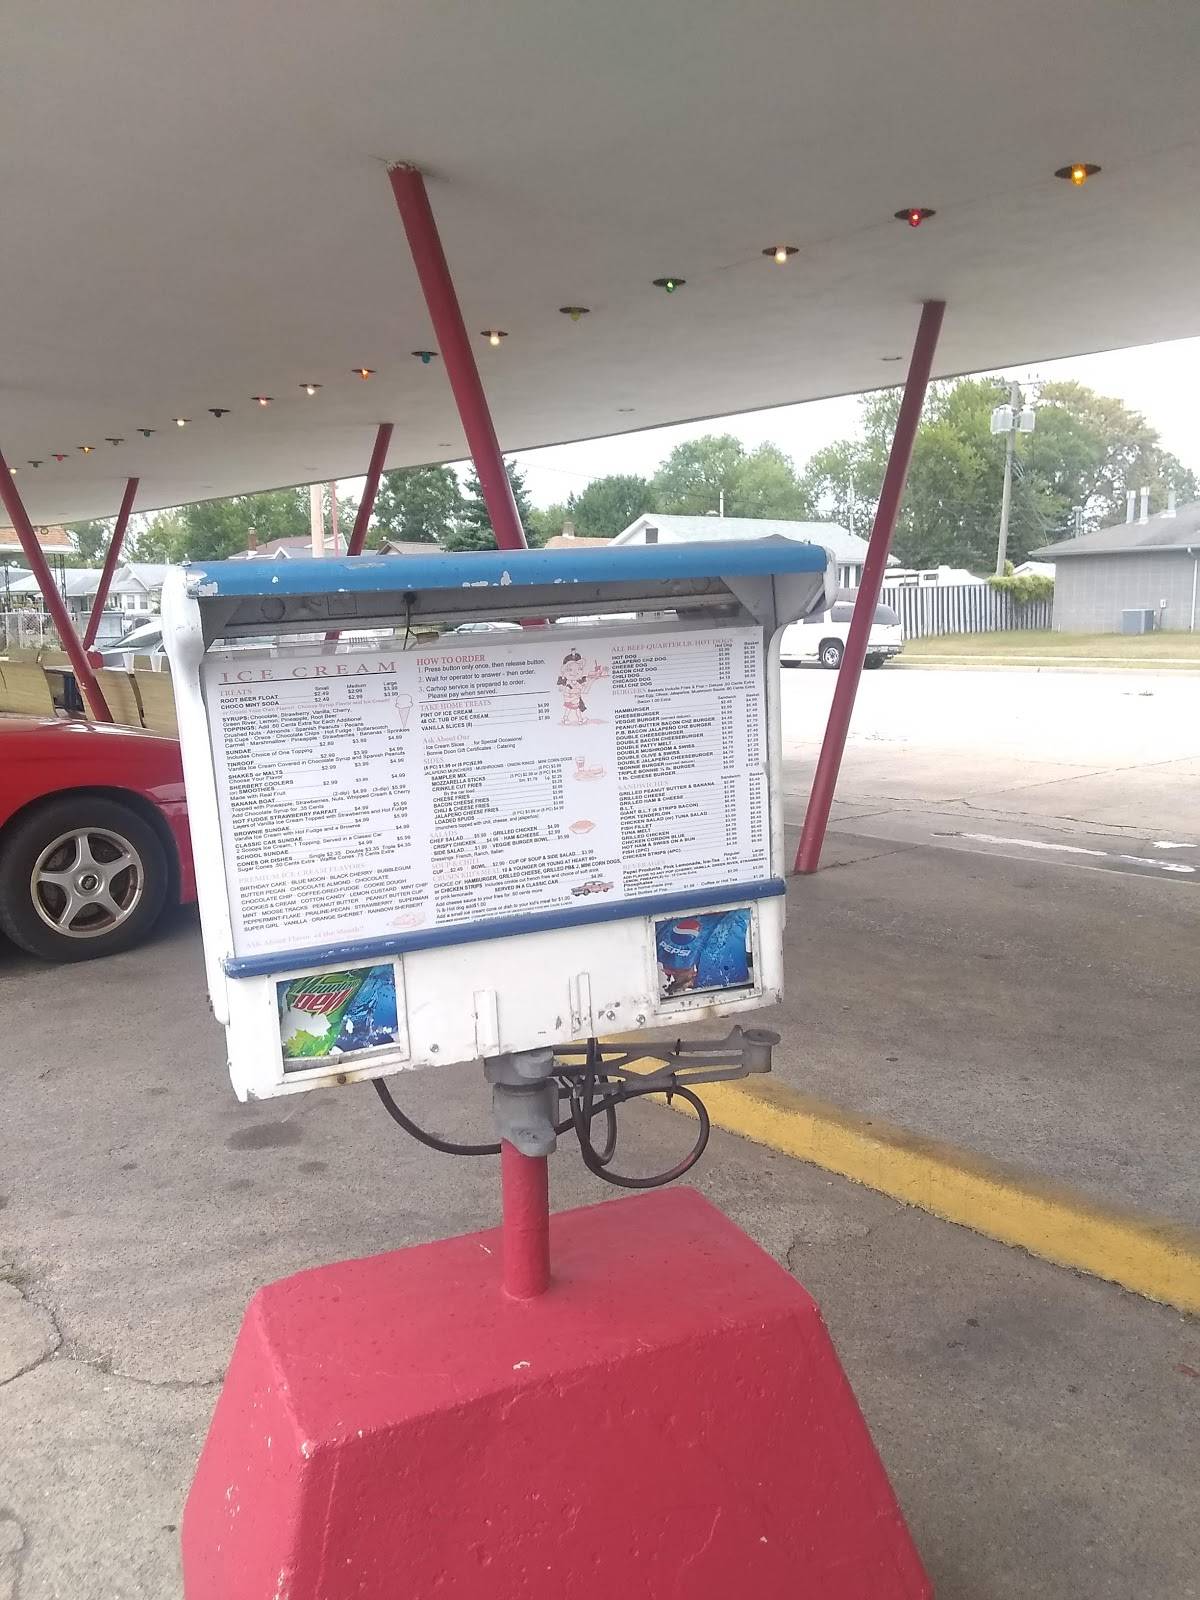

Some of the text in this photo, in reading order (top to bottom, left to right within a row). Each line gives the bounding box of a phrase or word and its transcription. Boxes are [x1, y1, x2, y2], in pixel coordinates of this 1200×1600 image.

[416, 654, 486, 666] HOW TO ORDER
[424, 666, 442, 674] Press
[505, 660, 526, 668] release
[220, 660, 397, 683] ICE CREAM
[449, 673, 473, 681] operator
[481, 671, 502, 679] answer
[426, 685, 448, 693] Carhop
[448, 683, 469, 691] service
[476, 680, 502, 689] prepared
[428, 692, 448, 700] Please
[421, 724, 445, 732] VANILLA
[231, 800, 258, 808] BANANA
[453, 799, 475, 807] CHEESE
[235, 841, 262, 849] CLASSIC
[236, 853, 263, 861] SCHOOL
